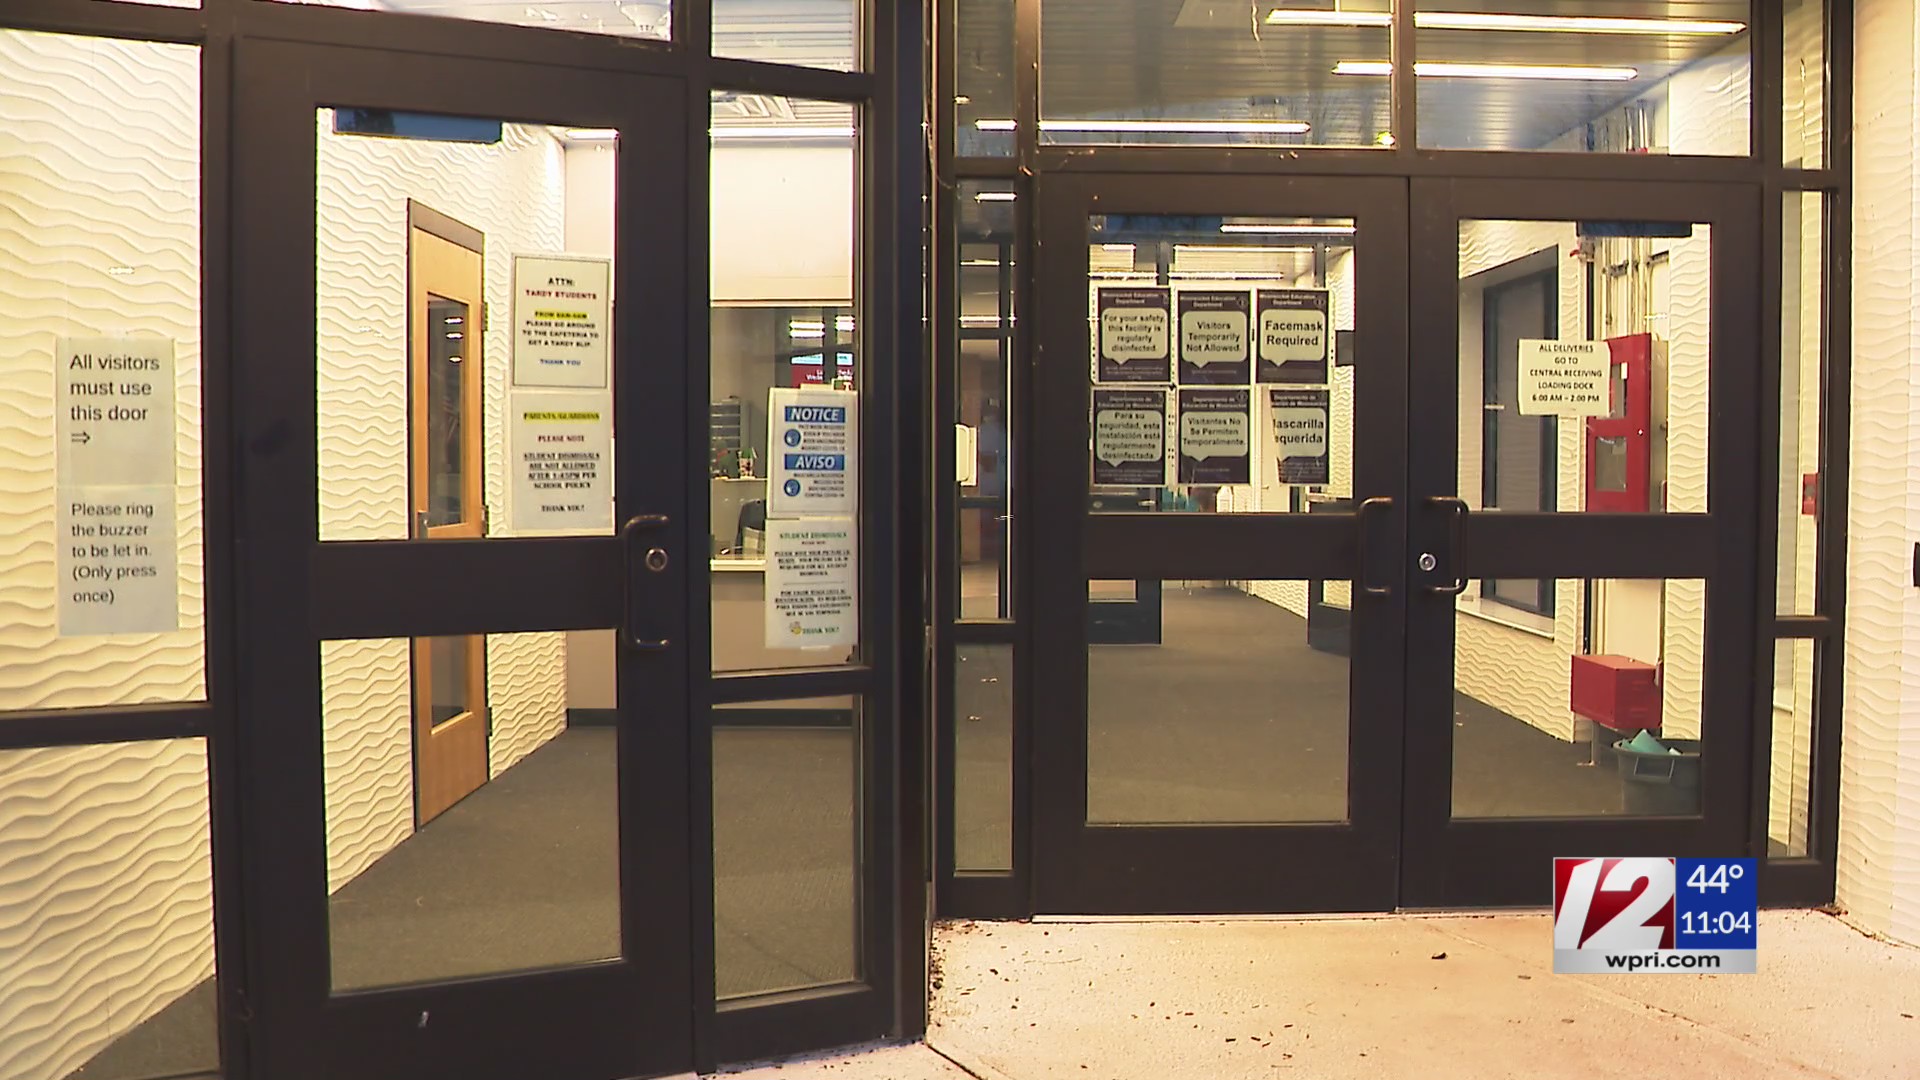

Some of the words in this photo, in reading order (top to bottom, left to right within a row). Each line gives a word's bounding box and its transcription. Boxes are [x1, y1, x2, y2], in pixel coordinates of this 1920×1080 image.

[549, 278, 575, 286] ATTN:
[555, 291, 597, 300] STUDENTS
[1126, 325, 1152, 333] facility
[1197, 322, 1231, 330] Visitors
[1265, 320, 1323, 331] Facemask
[1117, 335, 1152, 343] regularly
[1189, 333, 1240, 342] Temporarily
[1267, 335, 1319, 347] Required
[1187, 344, 1202, 352] Not
[1204, 344, 1241, 352] Allowed.
[1554, 345, 1594, 353] DELIVERIES
[70, 354, 93, 370] All
[99, 354, 160, 370] visitors
[1530, 369, 1562, 377] CENTRAL
[70, 381, 114, 396] must
[120, 382, 152, 396] use
[1574, 382, 1594, 390] DOCK
[1550, 394, 1562, 402] AM
[71, 405, 102, 421] this
[109, 405, 148, 421] door
[524, 412, 600, 420] PARENTS/GUARDIANS
[790, 408, 840, 421] NOTICE
[1273, 419, 1324, 429] ascarilla
[1183, 438, 1246, 447] Temporalmente.
[1275, 434, 1322, 445] equerida
[1103, 442, 1156, 450] regularmente
[795, 456, 835, 469] AVISO
[71, 503, 122, 517] Please
[126, 503, 154, 520] ring
[71, 524, 95, 537] the
[100, 524, 149, 537] buzzer
[72, 545, 86, 558] to
[91, 545, 108, 558] be
[114, 544, 131, 557] let
[135, 544, 152, 557] in.
[73, 565, 112, 581] (Only
[117, 565, 157, 580] press
[73, 589, 115, 605] once)
